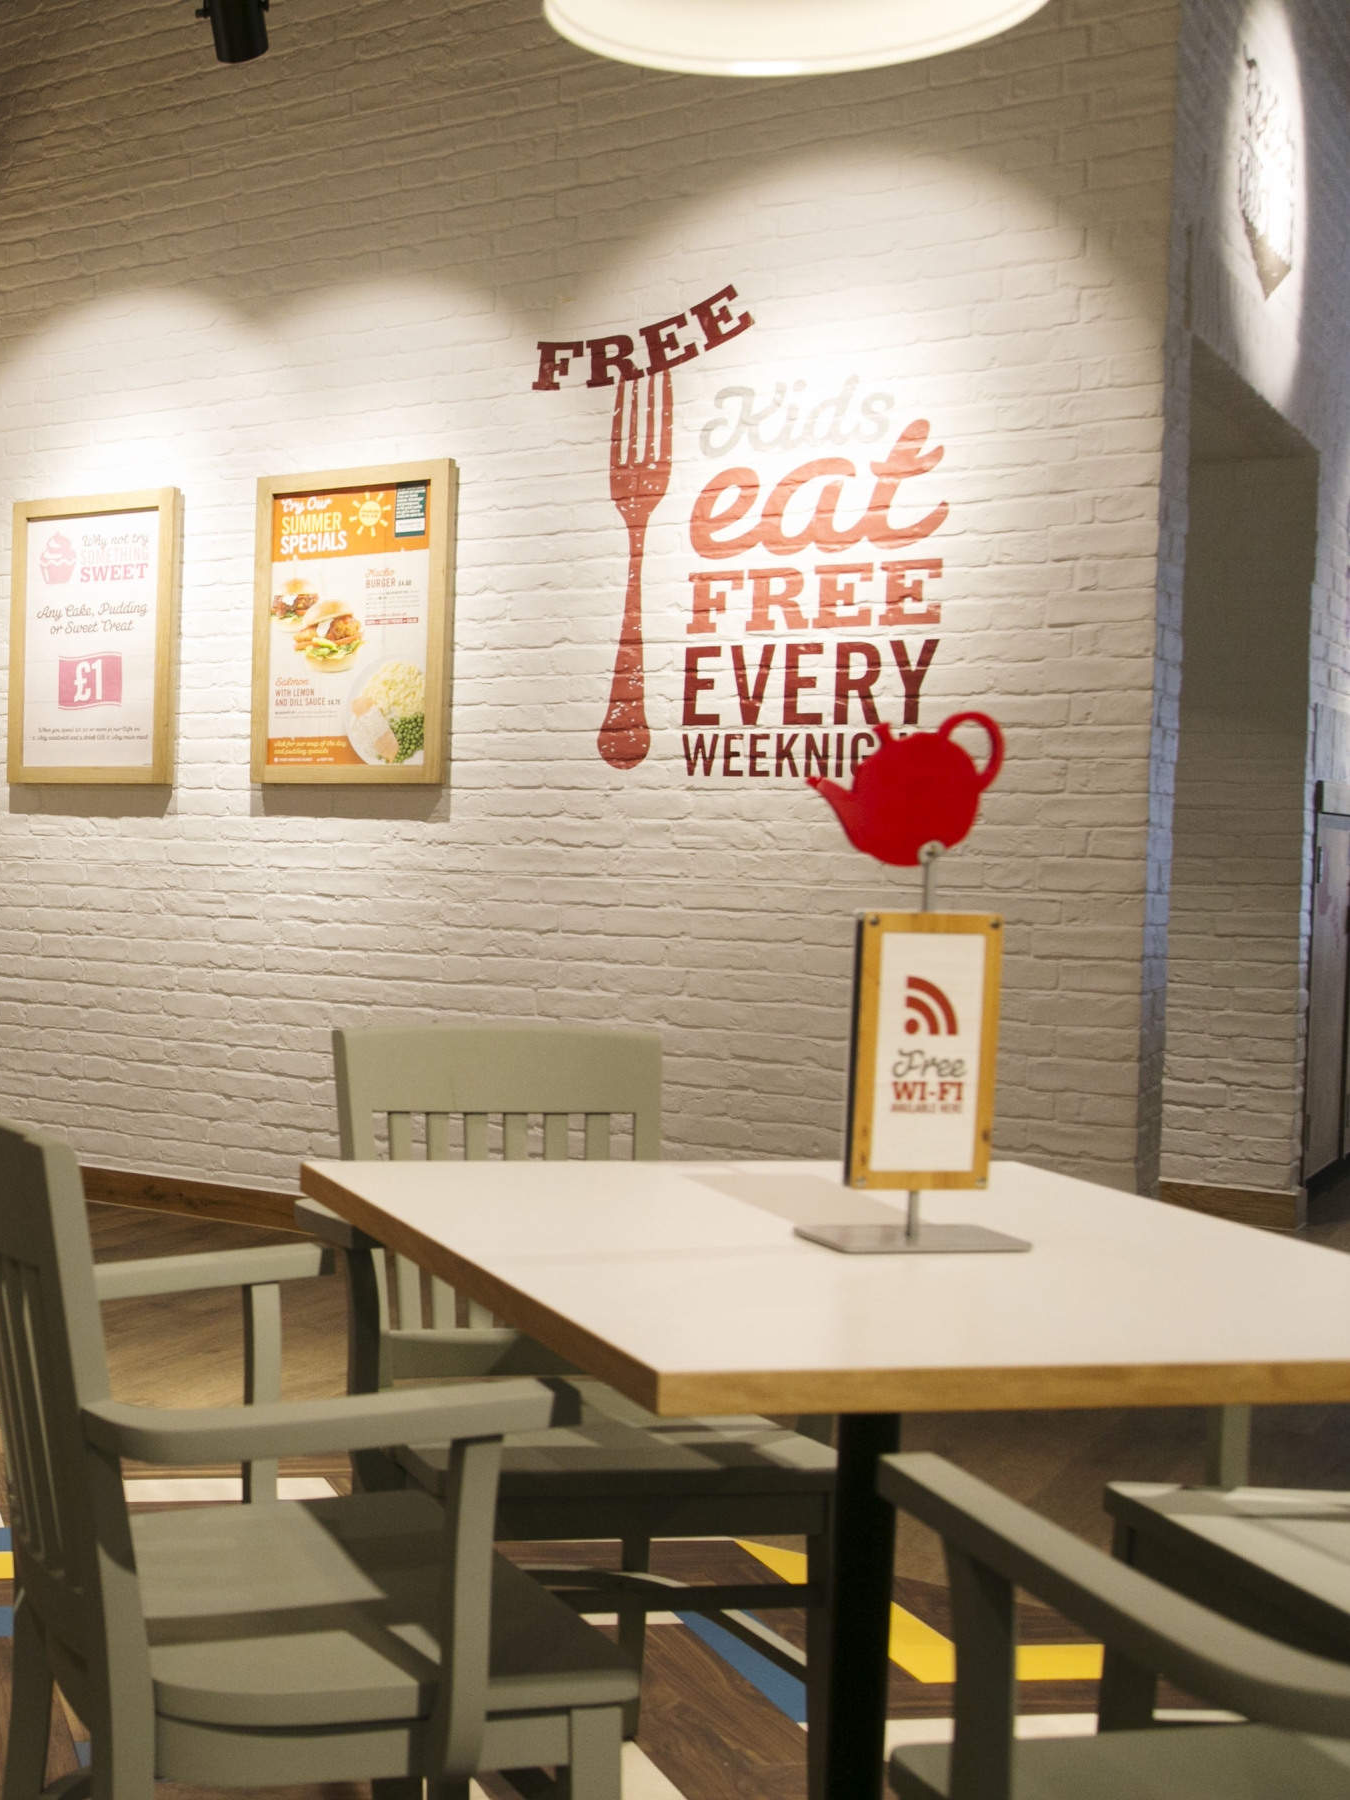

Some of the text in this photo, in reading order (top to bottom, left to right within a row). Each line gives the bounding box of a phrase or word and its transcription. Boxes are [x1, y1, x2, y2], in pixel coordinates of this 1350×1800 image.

[532, 283, 755, 391] FREE
[698, 373, 895, 459] Kids
[689, 418, 950, 561] eat
[281, 496, 333, 515] Try Our
[281, 511, 342, 535] SUMMER
[81, 532, 149, 550] Why not try
[280, 530, 348, 555] SPECIALS
[80, 546, 149, 565] SOMETHING
[80, 563, 148, 583] SWEET
[365, 578, 396, 588] BURGER
[686, 558, 944, 635] FREE
[37, 601, 149, 621] Any Cake, Pudding
[50, 619, 134, 635] or Sweet Treat
[73, 658, 103, 702] £1
[275, 677, 309, 687] Salmon
[681, 638, 941, 727] EVERY
[275, 688, 315, 697] WITH LEMON
[275, 698, 288, 707] AND
[290, 698, 303, 706] DILL
[305, 697, 326, 706] SAUCE
[682, 732, 938, 779] WEEKNIG
[892, 1049, 967, 1078] Free
[892, 1081, 963, 1101] WI-FI
